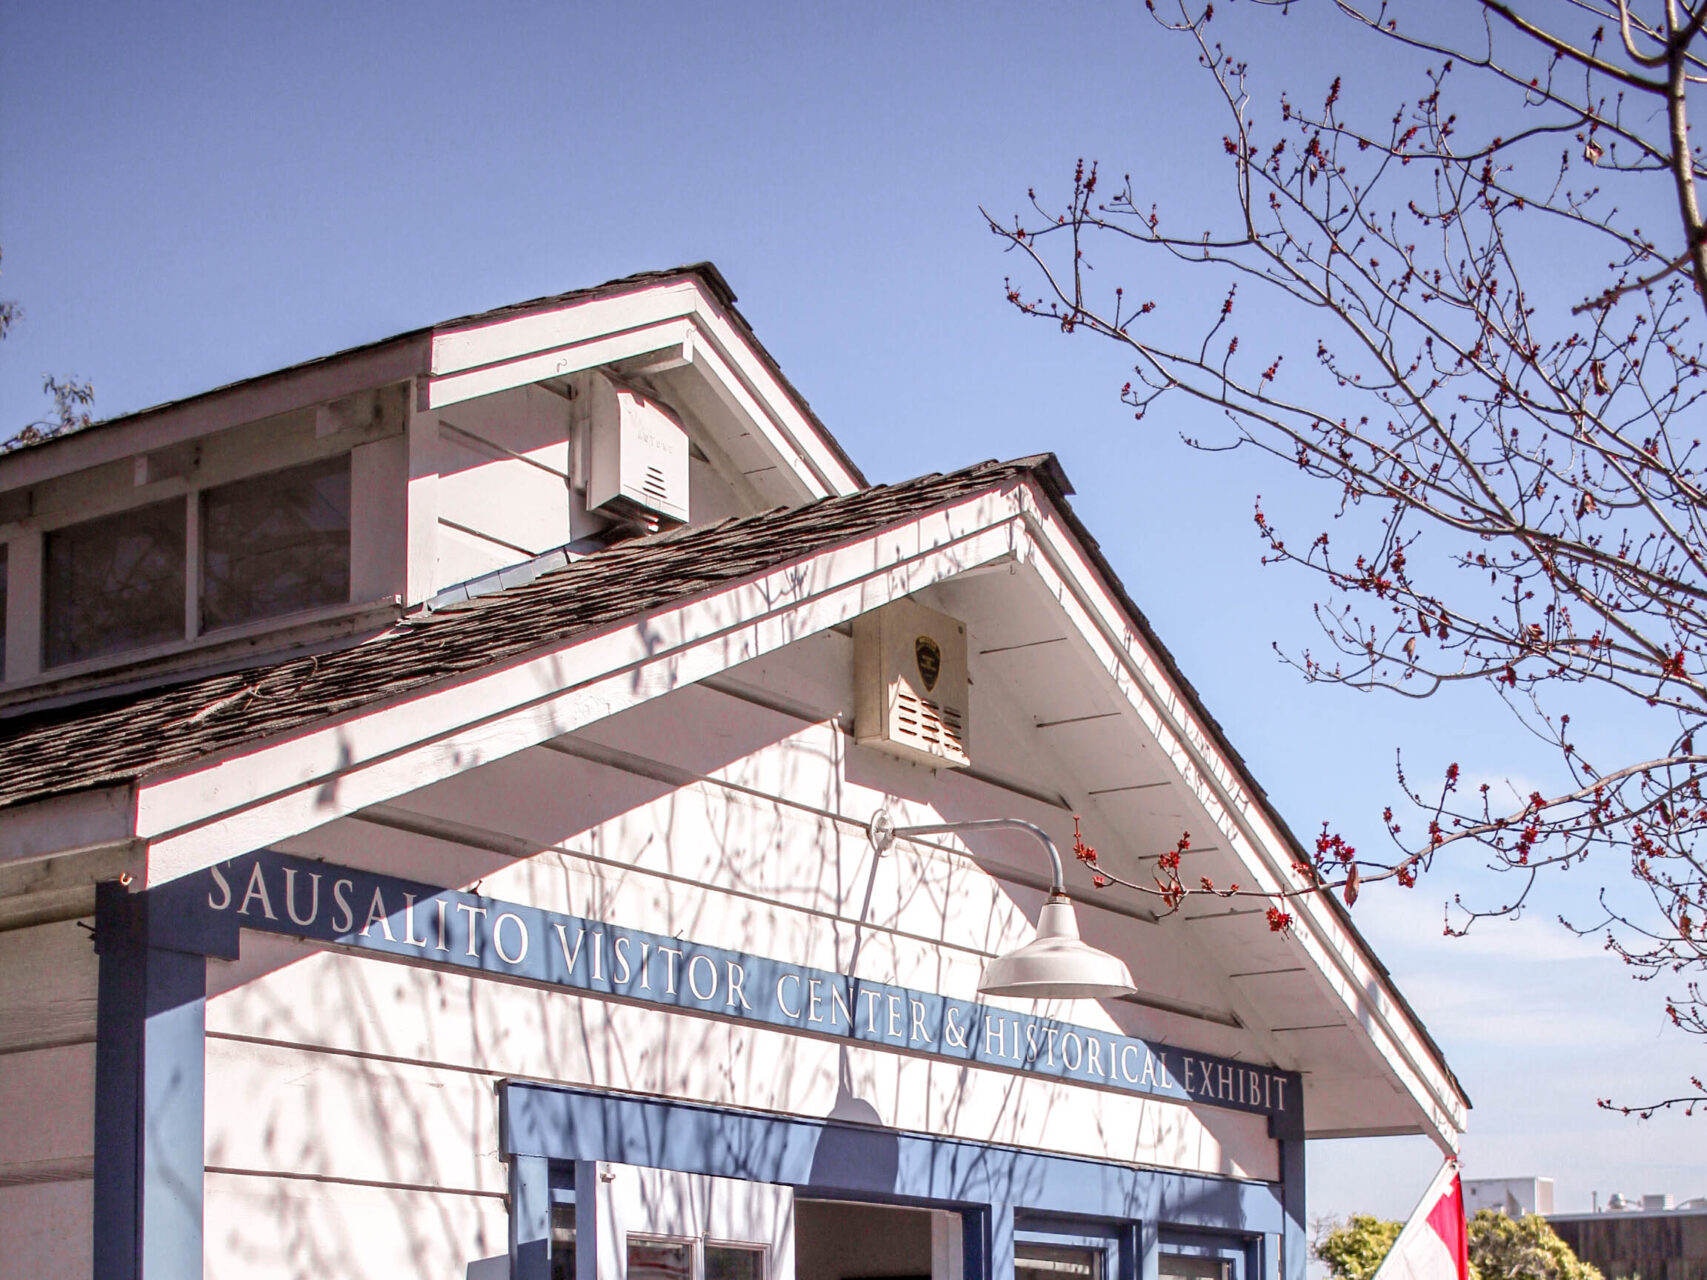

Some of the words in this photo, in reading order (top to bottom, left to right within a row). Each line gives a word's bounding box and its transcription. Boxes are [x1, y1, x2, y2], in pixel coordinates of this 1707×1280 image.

[208, 860, 529, 965] SAUSALITO
[553, 923, 752, 1011] VISITOR
[776, 973, 932, 1044] CENTER
[945, 1006, 969, 1050] &
[984, 1014, 1173, 1090] HISTORICAL
[1184, 1056, 1288, 1111] EXHIBIT
